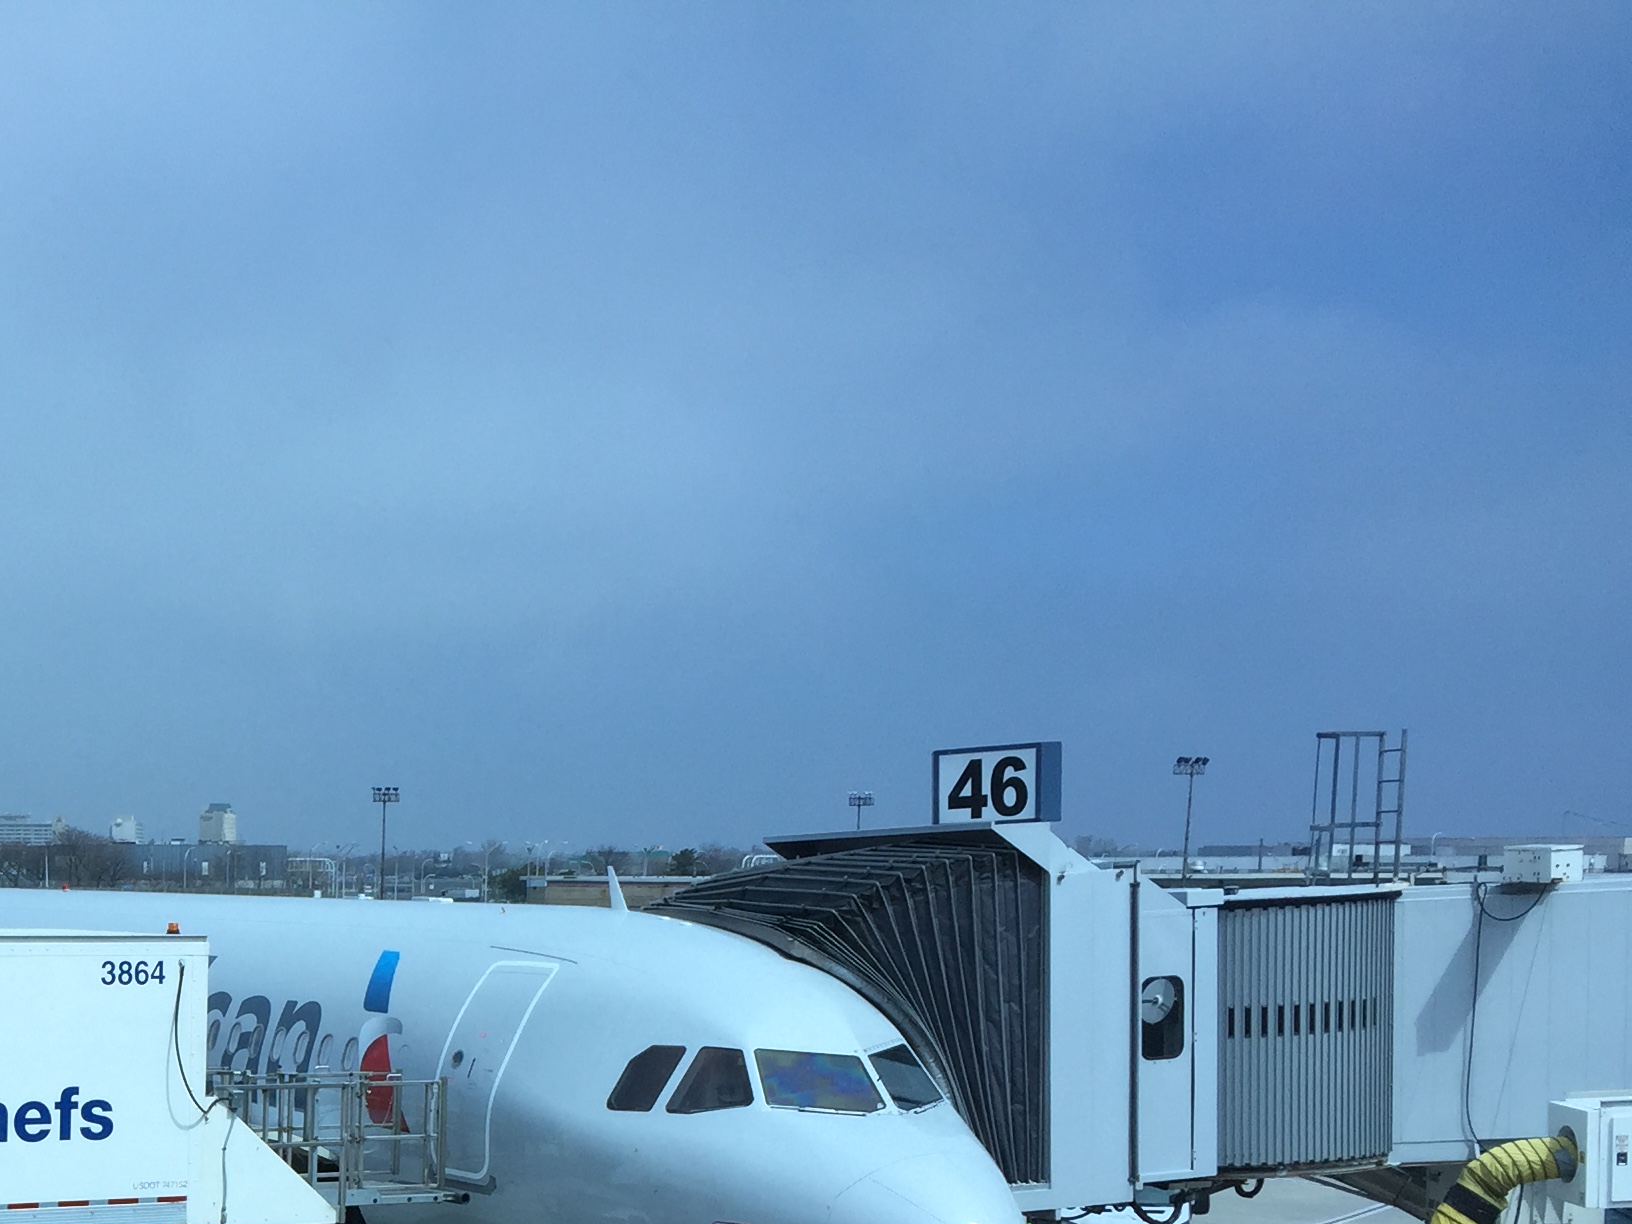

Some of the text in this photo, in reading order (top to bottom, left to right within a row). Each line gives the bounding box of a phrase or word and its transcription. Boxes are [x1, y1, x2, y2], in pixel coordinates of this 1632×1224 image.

[948, 756, 1028, 819] 46
[101, 960, 166, 985] 3864
[132, 1181, 160, 1190] USDOT
